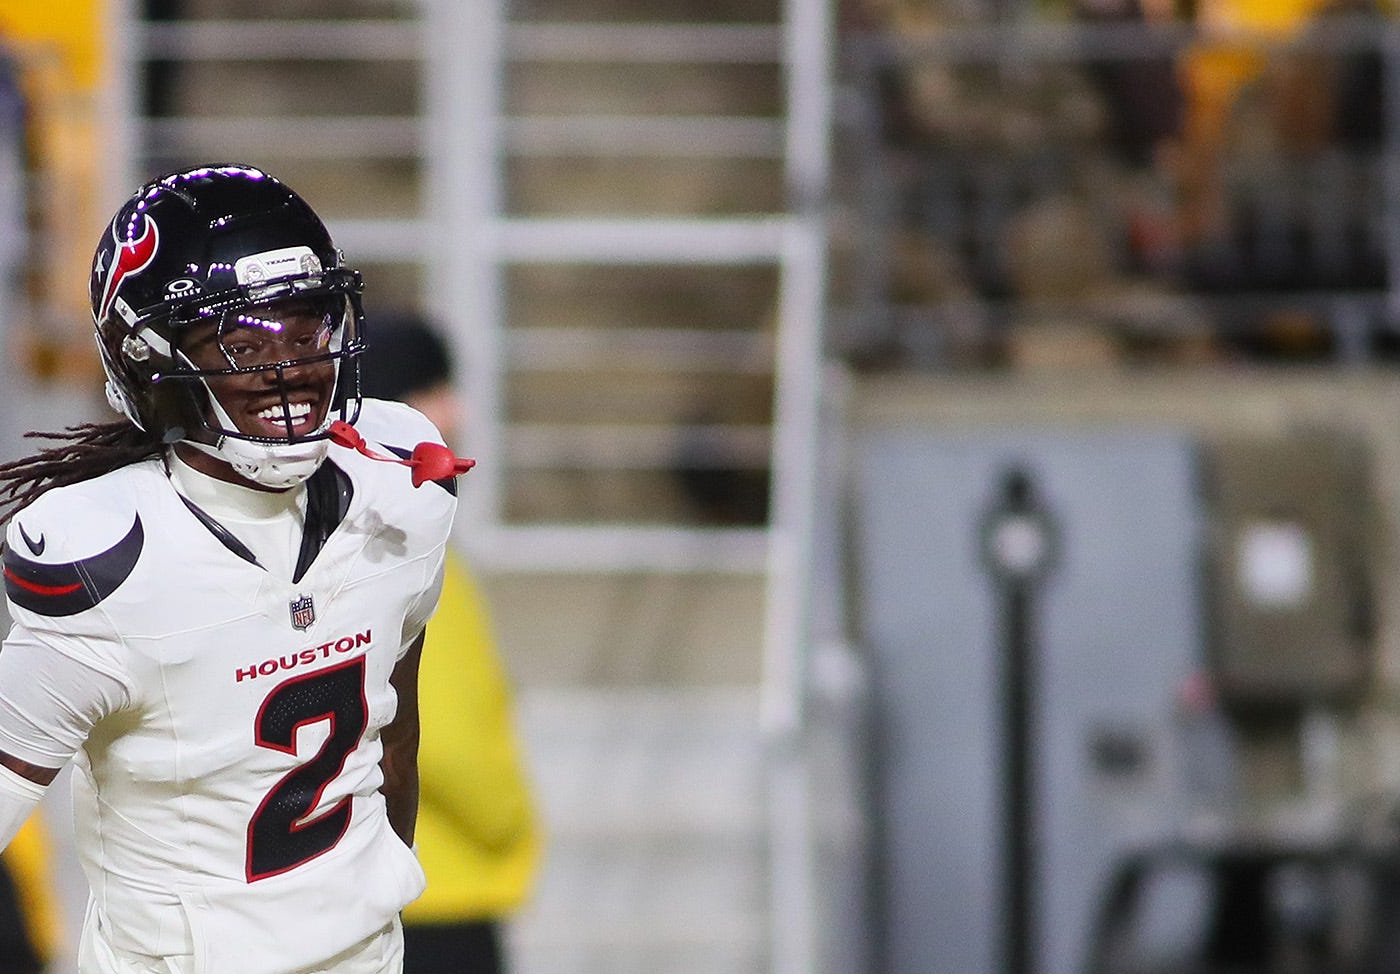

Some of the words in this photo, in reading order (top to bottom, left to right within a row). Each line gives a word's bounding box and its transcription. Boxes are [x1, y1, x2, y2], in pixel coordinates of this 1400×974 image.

[164, 288, 201, 301] OAKLEY
[235, 629, 372, 682] HOUSTON
[245, 653, 369, 884] 2
